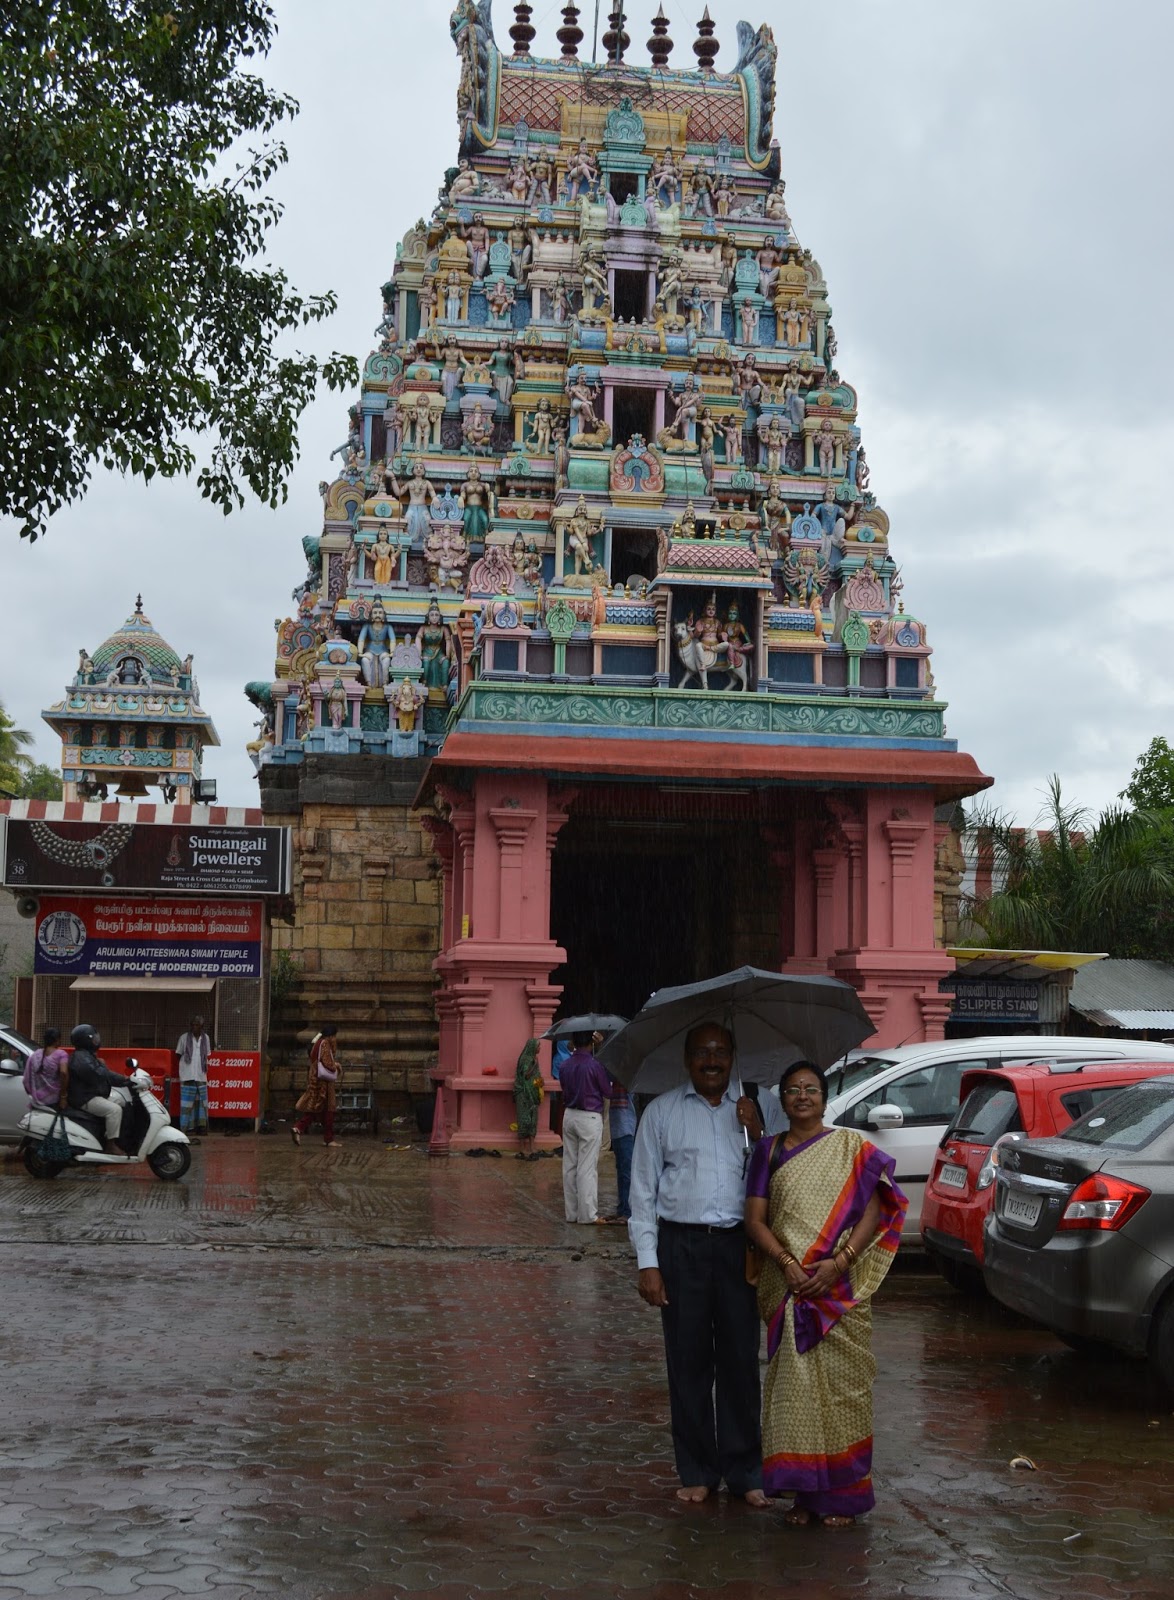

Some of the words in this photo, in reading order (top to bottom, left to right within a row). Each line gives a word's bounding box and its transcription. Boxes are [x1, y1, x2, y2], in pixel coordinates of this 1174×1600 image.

[189, 836, 267, 853] Sumangali
[192, 851, 262, 866] Jewellers
[12, 865, 24, 875] 38
[125, 918, 152, 933] நவீன
[154, 919, 206, 934] புறக்காவல்
[207, 920, 249, 935] நிலையம்
[96, 947, 135, 957] ARULMIGU
[136, 948, 190, 958] PATTEESWARA
[191, 949, 218, 958] SWAMY
[219, 950, 248, 958] TEMPLE
[90, 961, 120, 970] PERUR
[123, 962, 157, 971] POLICE
[159, 963, 219, 972] MODERNIZED
[222, 964, 254, 972] BOOTH
[960, 999, 1003, 1010] SLIPPER
[1007, 1000, 1038, 1010] STAND
[225, 1058, 253, 1067] 2220077
[225, 1080, 252, 1088] 2607180
[224, 1102, 252, 1110] 2607924
